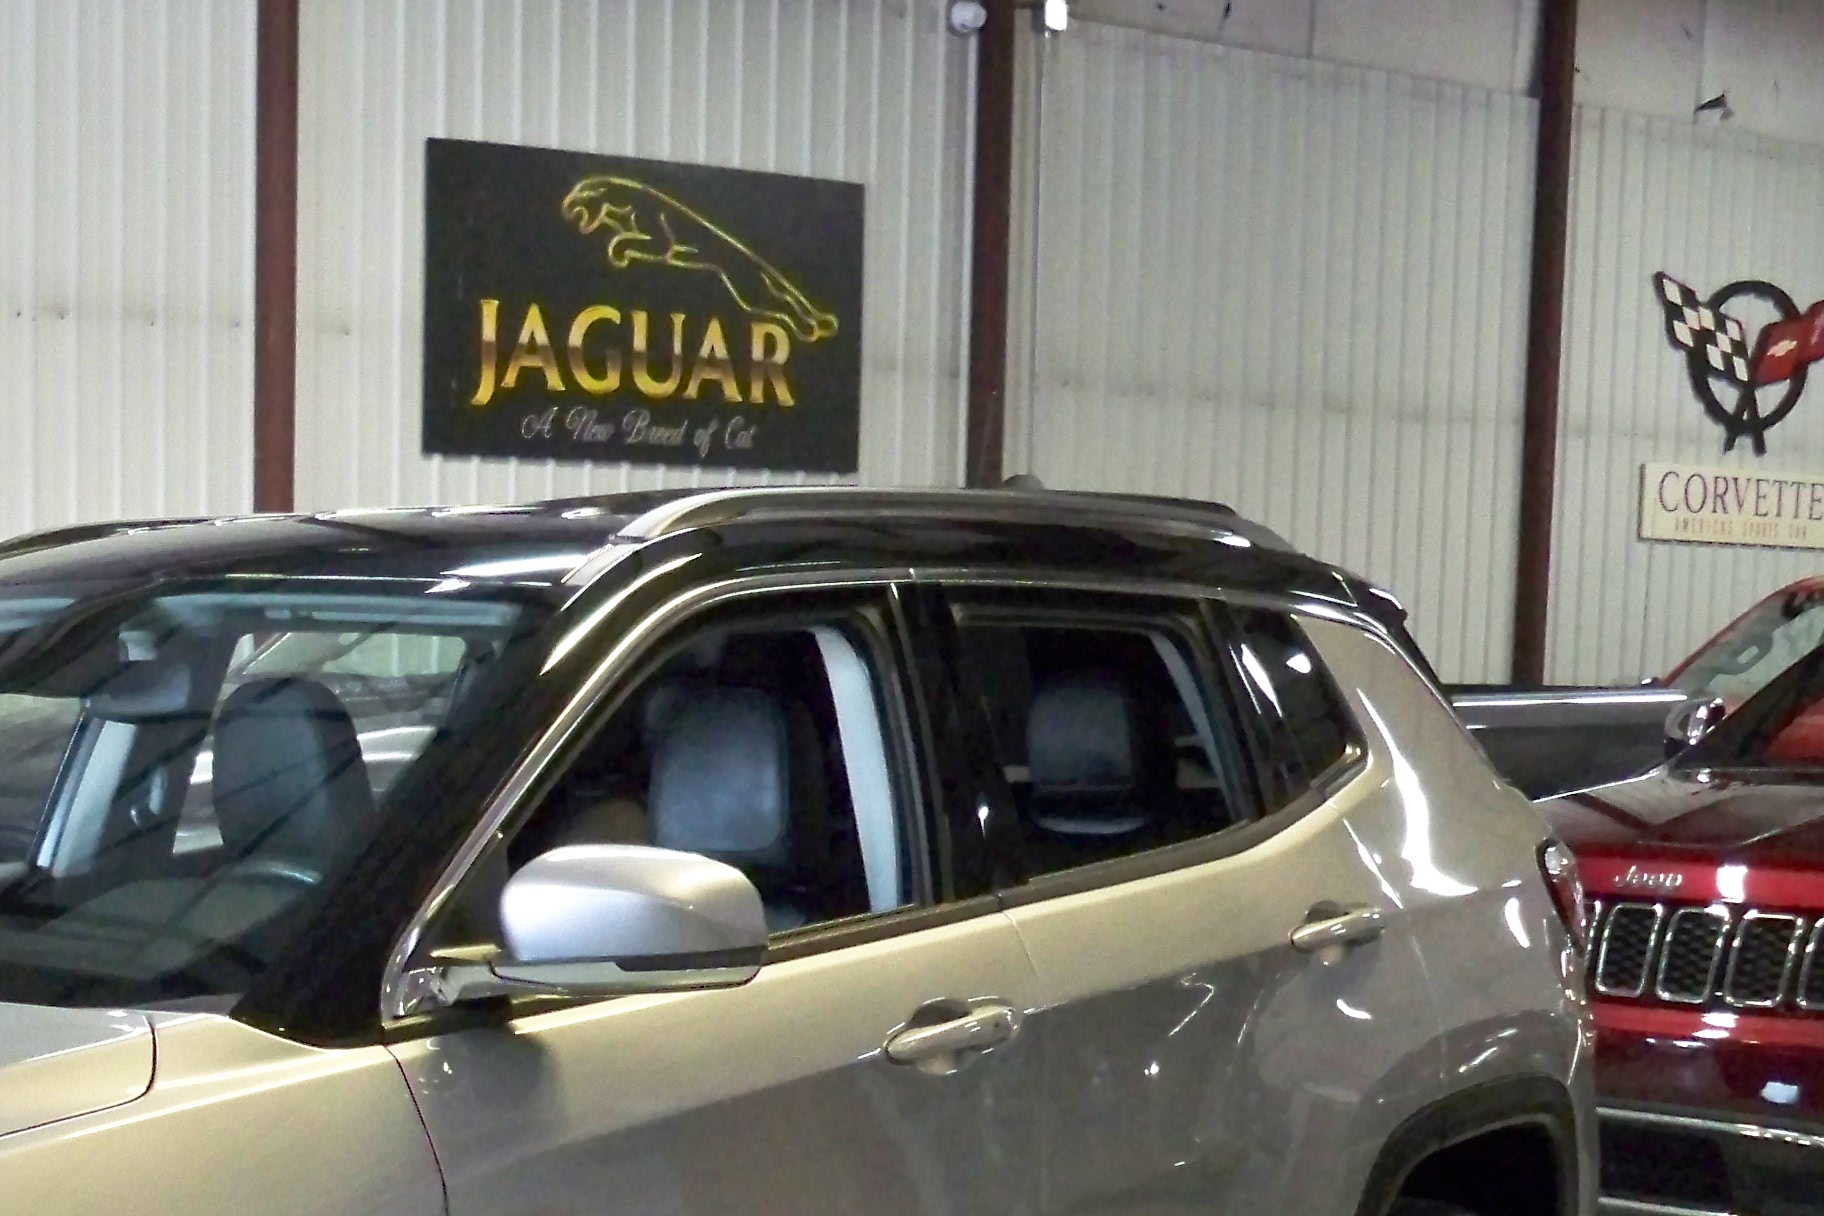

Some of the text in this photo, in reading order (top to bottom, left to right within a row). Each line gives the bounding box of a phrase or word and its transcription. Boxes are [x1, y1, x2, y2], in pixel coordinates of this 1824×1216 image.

[470, 299, 795, 407] JAGUAR
[521, 406, 559, 439] A
[693, 419, 719, 458] of
[1659, 471, 1824, 521] CORVETTE
[1613, 864, 1684, 888] Jeep
